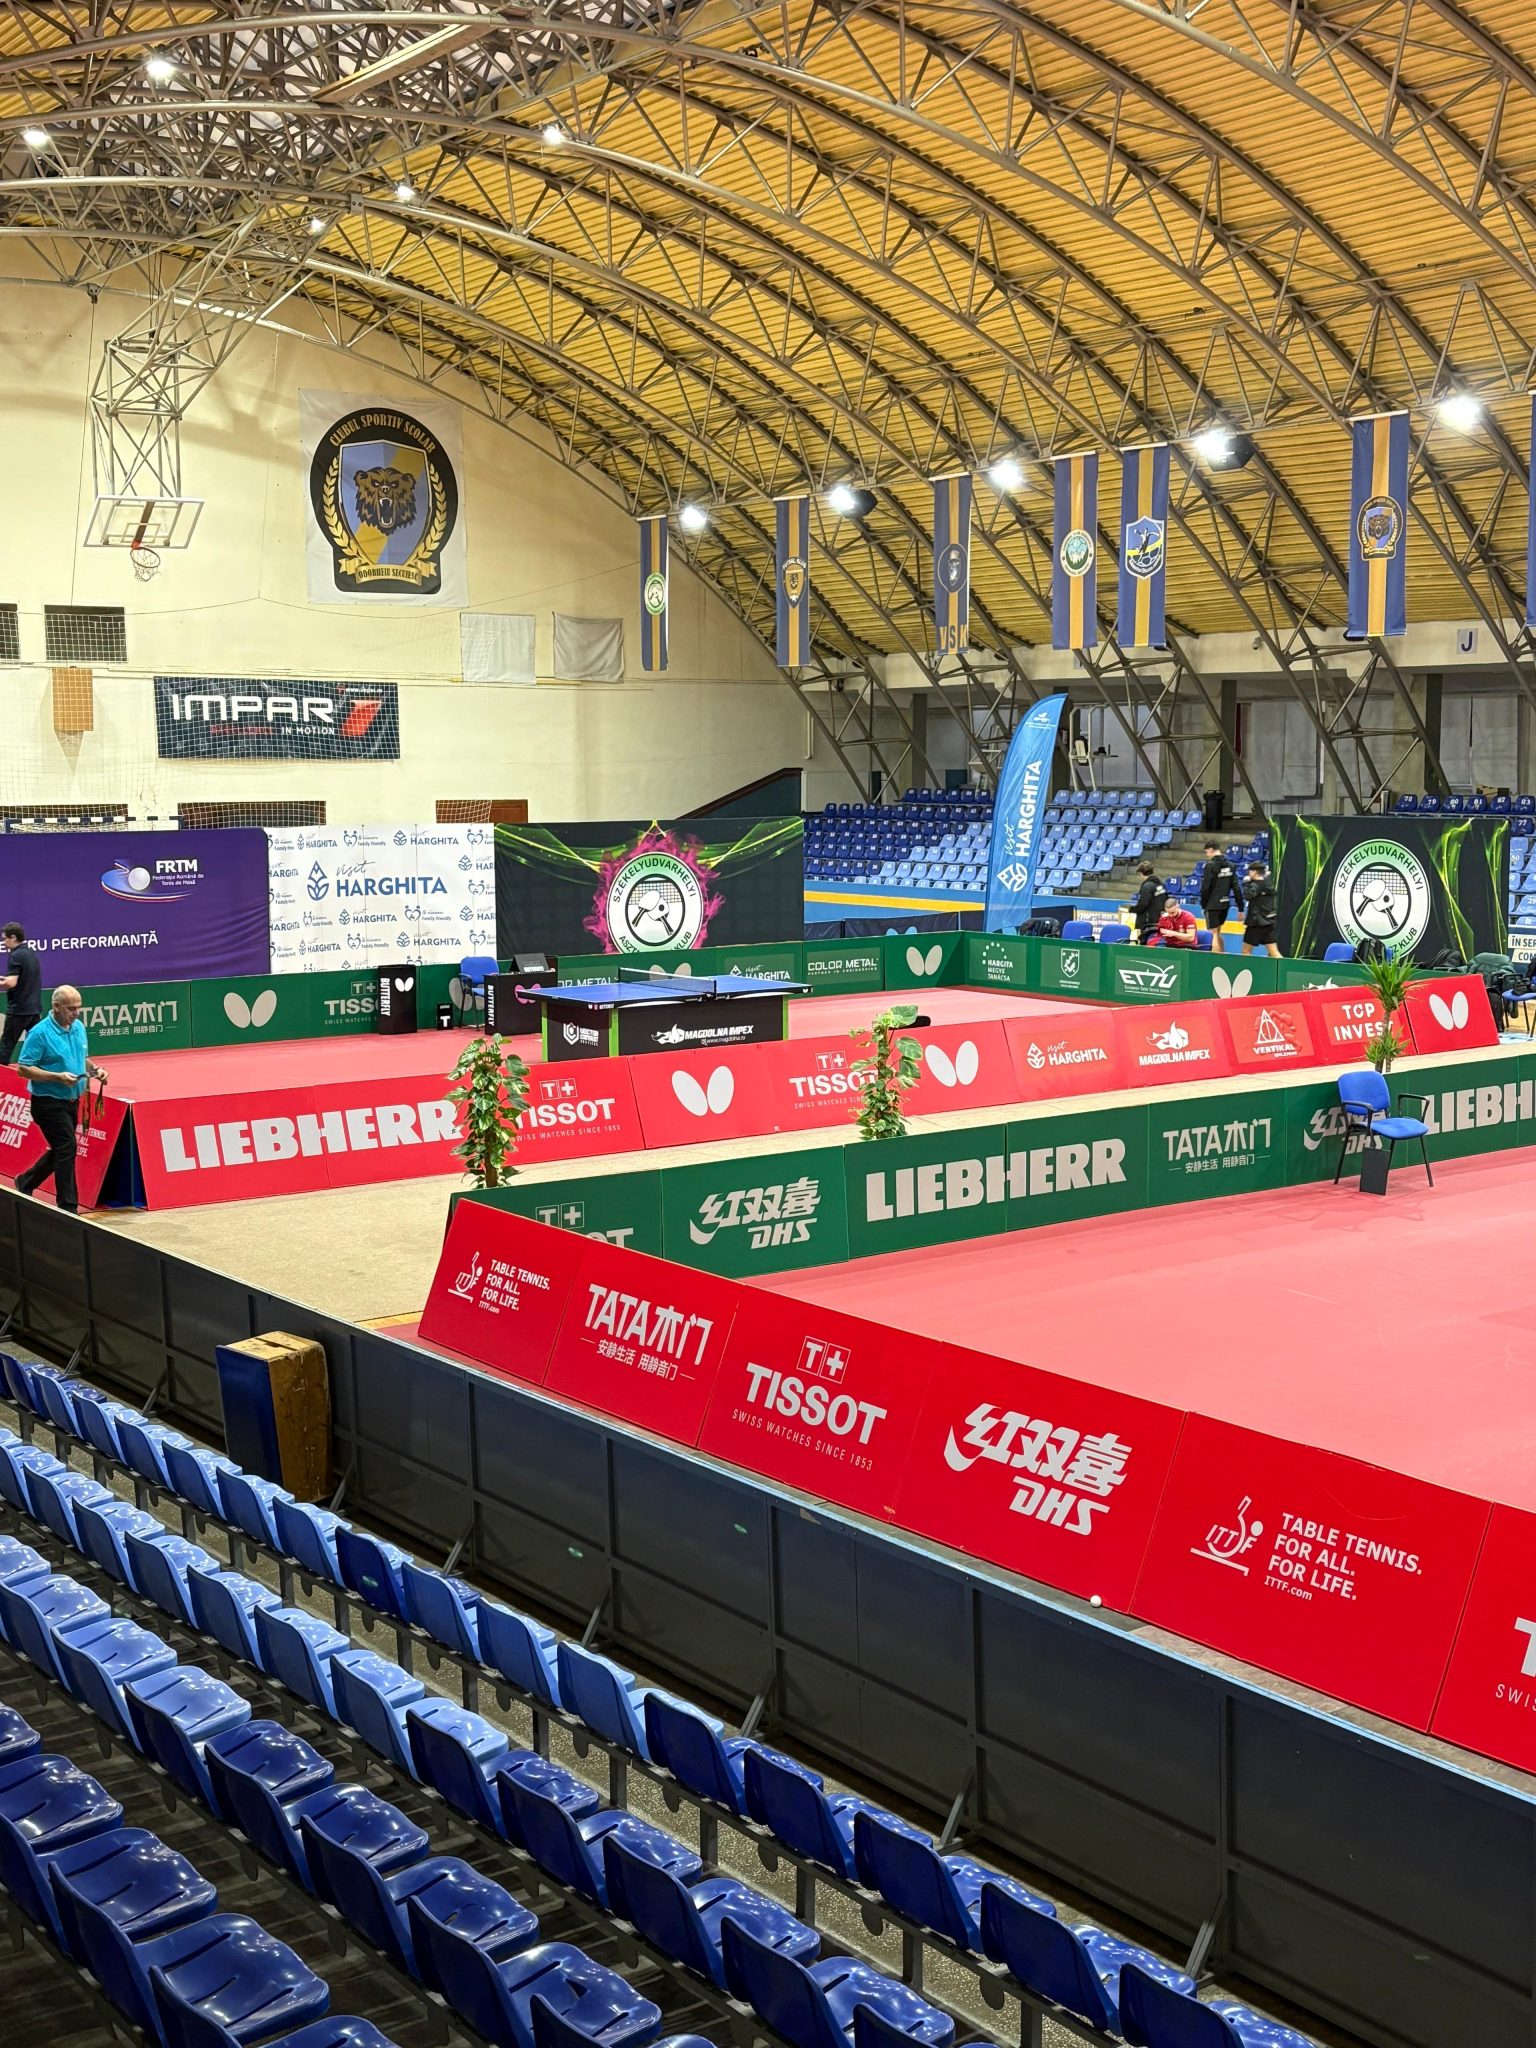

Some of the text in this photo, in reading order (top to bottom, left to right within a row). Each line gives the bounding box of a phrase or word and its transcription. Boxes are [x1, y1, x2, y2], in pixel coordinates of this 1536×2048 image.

[329, 413, 437, 454] CLUBUL SPORTIV SCOLAR
[1461, 631, 1473, 652] J
[171, 694, 335, 723] IMPAR
[281, 726, 292, 734] IN
[297, 726, 335, 735] MOTION
[1014, 759, 1043, 857] HARGHITA
[410, 837, 459, 845] HARGHITA
[156, 859, 198, 874] FRTM
[336, 860, 376, 877] visit
[613, 857, 697, 903] SZÉKELYUDVARHELYI
[1338, 845, 1424, 889] SZÉKELYUDVARHELYI
[336, 876, 448, 897] HARGHITA
[353, 914, 398, 923] HARGHITA
[51, 931, 159, 951] PERFORMANȚĂ
[413, 938, 462, 946] HARGHITA
[1399, 927, 1418, 949] KLUB
[807, 958, 878, 972] COLOR METAL
[1118, 968, 1178, 988] ETTU
[323, 997, 379, 1016] TISS
[380, 978, 391, 1017] BUTTERFLY
[487, 985, 495, 1027] BUTTERFLY
[685, 1024, 754, 1040] MAGDOLNA IMPEX
[1049, 1047, 1107, 1066] HARGHITA
[1138, 1048, 1211, 1066] MAGDOLNA IMPEX
[1253, 1044, 1296, 1055] VERTIKAL
[159, 1099, 464, 1173] LIEBHERR
[539, 1128, 576, 1140] WATCHES
[578, 1126, 601, 1135] SINCE
[1162, 1116, 1272, 1161] TATA木门
[1184, 1153, 1256, 1174] 安静生活 用静音门
[865, 1138, 1127, 1223] LIEBHERR
[689, 1175, 821, 1246] 红双喜
[747, 1217, 818, 1250] DHS
[485, 1272, 521, 1296] FOR ALL.
[490, 1258, 551, 1291] TABLE TENNIS.
[478, 1300, 500, 1315] ITTF.com
[481, 1288, 520, 1311] FOR LIFE.
[584, 1283, 714, 1366] TATA木门
[596, 1339, 678, 1382] 安静生活 用静音门
[746, 1361, 888, 1445] TISSOT
[732, 1408, 873, 1471] SWISS WATCHES SINCE 1853
[943, 1402, 1133, 1497] 红双喜
[1008, 1475, 1111, 1536] DHS
[1274, 1533, 1356, 1576] FOR ALL.
[1281, 1512, 1423, 1576] TABLE TENNIS.
[1263, 1574, 1313, 1602] ITTF.com
[1267, 1555, 1358, 1601] FOR LIFE.
